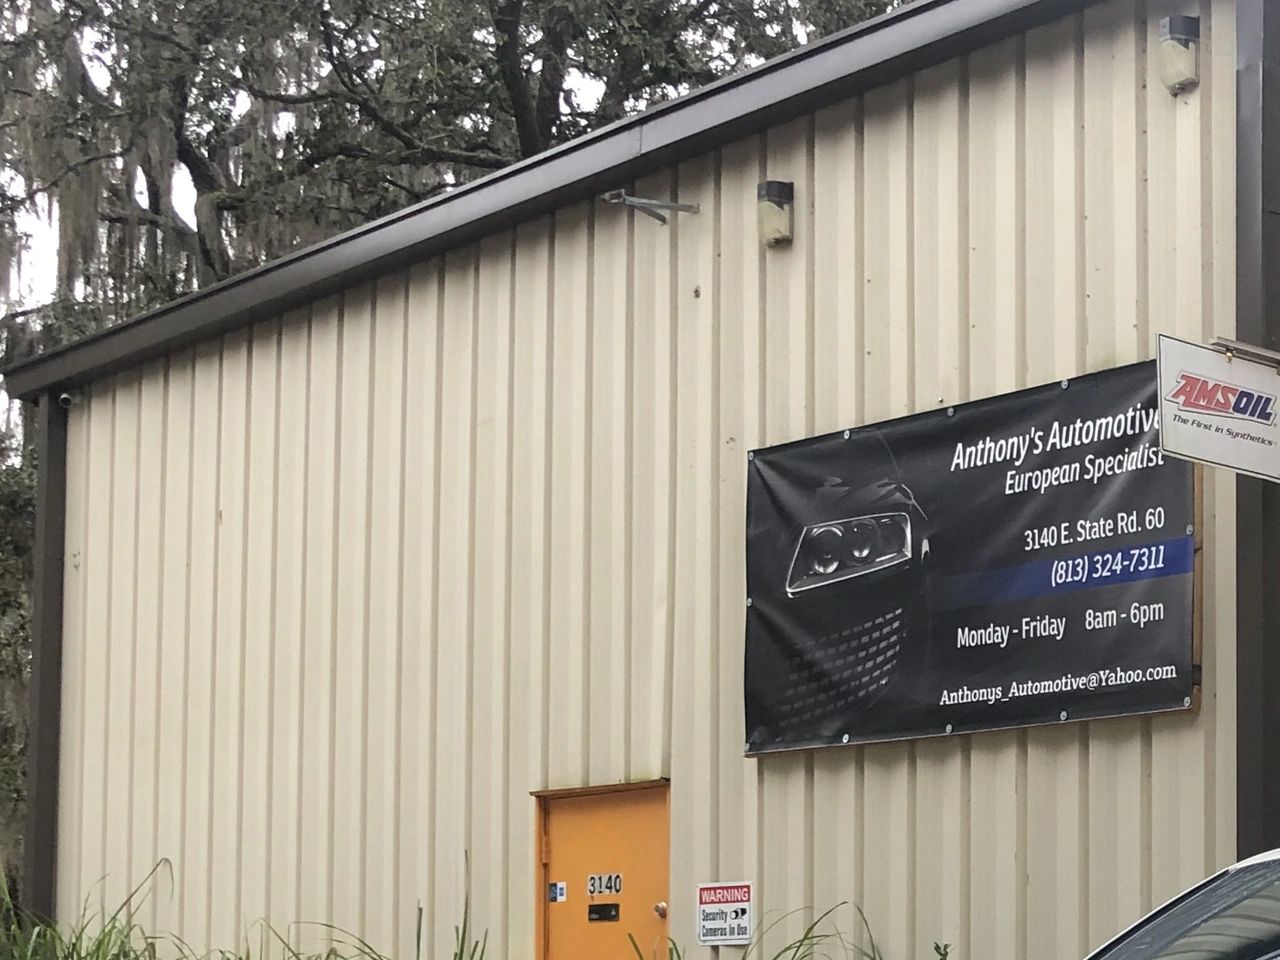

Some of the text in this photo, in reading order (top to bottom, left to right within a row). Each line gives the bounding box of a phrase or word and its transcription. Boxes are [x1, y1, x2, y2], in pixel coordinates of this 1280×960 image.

[1171, 374, 1273, 421] AMSOIL
[950, 426, 1044, 472] Anthony's
[1173, 414, 1273, 447] The First in Synthetics
[1004, 443, 1165, 495] European Specialist
[1024, 507, 1165, 551] 3140 E. State Rd. 60
[1051, 545, 1165, 587] (813) 324-7311
[956, 623, 1010, 649] Monday
[1022, 616, 1066, 641] Friday
[1085, 609, 1117, 630] 8am
[1130, 602, 1164, 628] 6pm
[939, 664, 1177, 706] Anthonys_Automotive@Yahoo.com
[588, 874, 622, 895] 3140
[700, 887, 749, 903] WARNING
[702, 908, 728, 924] Security
[702, 925, 727, 937] Cameras
[737, 923, 748, 936] Use
